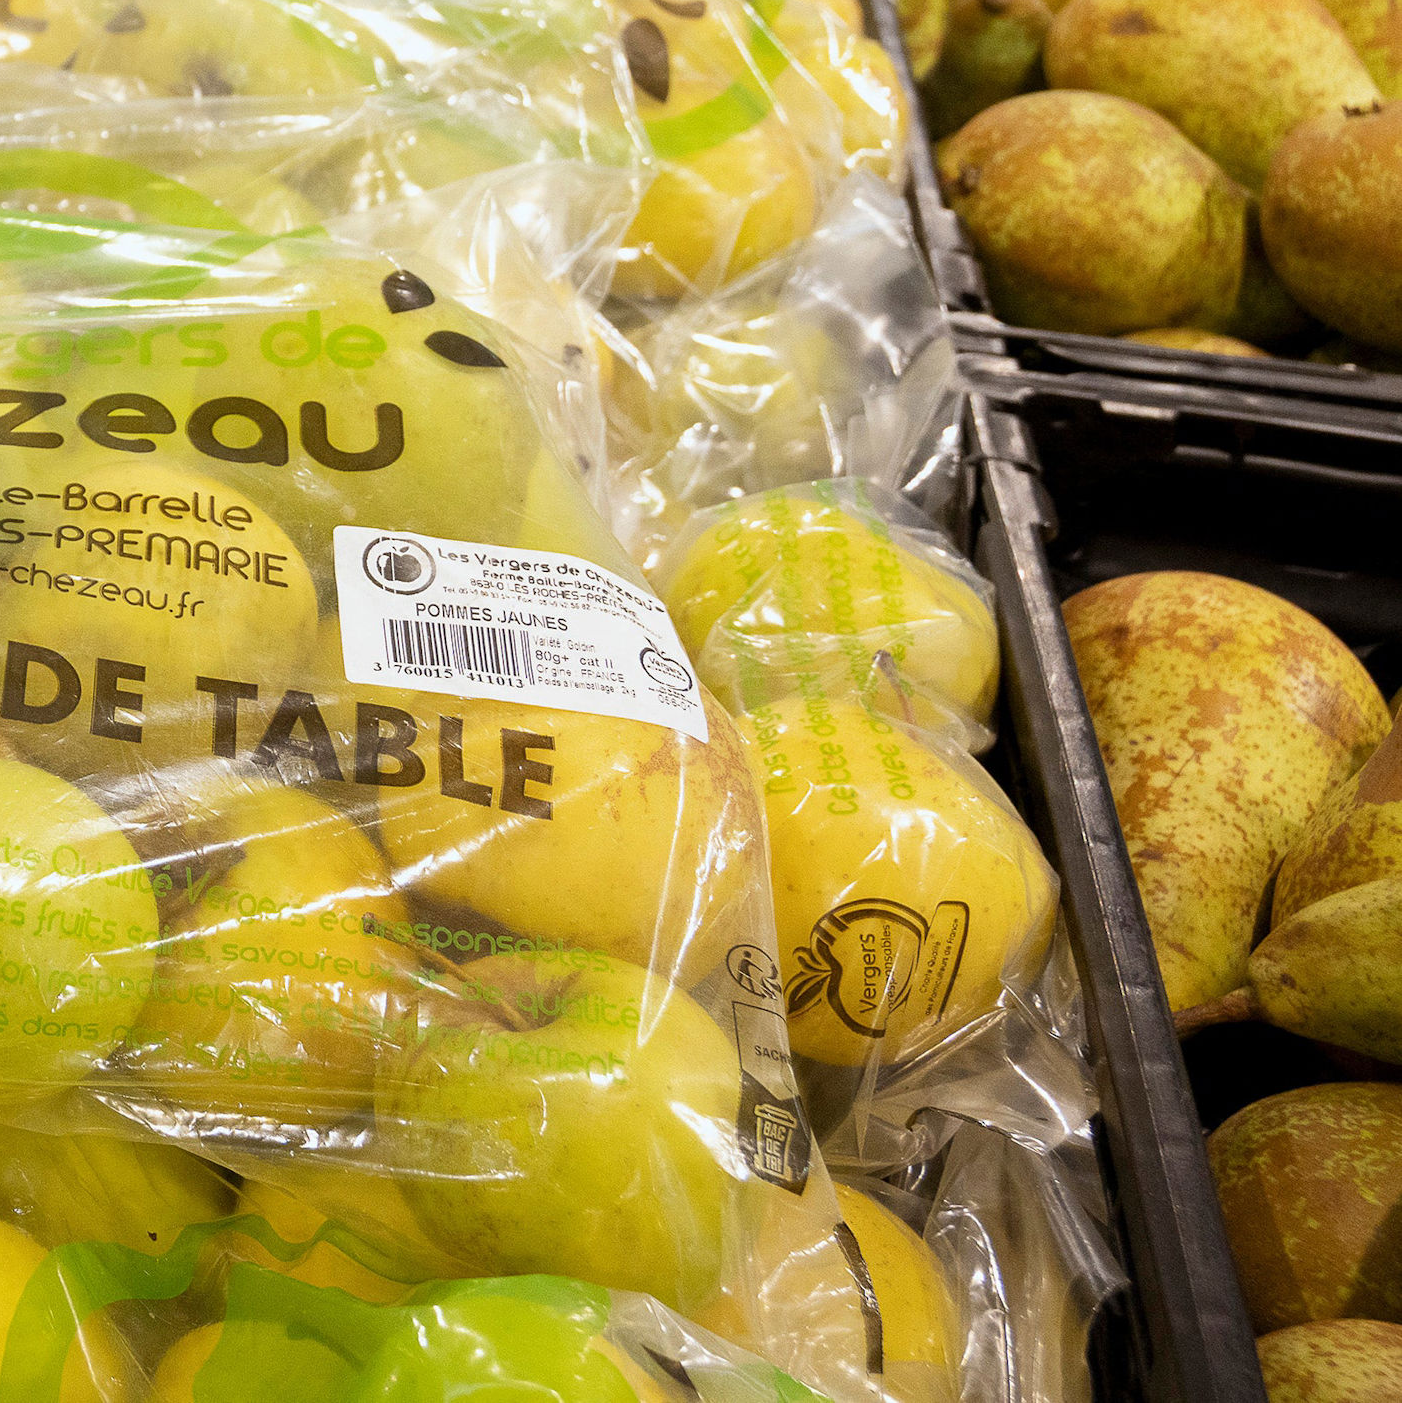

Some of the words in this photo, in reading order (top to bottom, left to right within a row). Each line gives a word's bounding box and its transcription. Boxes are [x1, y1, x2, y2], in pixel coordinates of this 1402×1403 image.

[259, 309, 388, 370] de
[437, 547, 470, 564] Les
[474, 553, 551, 574] Vergers
[556, 562, 581, 577] de
[415, 601, 493, 622] POMMES
[497, 609, 569, 632] JAUNES
[534, 649, 570, 665] 80g+
[579, 656, 600, 668] cat
[372, 660, 383, 673] 3
[393, 663, 454, 681] 760015
[465, 671, 526, 691] 411013
[580, 668, 626, 684] FRANCE
[195, 674, 556, 822] TABLE
[875, 741, 917, 802] avec
[32, 897, 118, 946] fruits
[220, 942, 396, 987] savoureux
[516, 989, 640, 1029] qualité
[858, 932, 882, 1014] Vergers
[21, 1014, 100, 1042] dans
[762, 1120, 787, 1141] BAC
